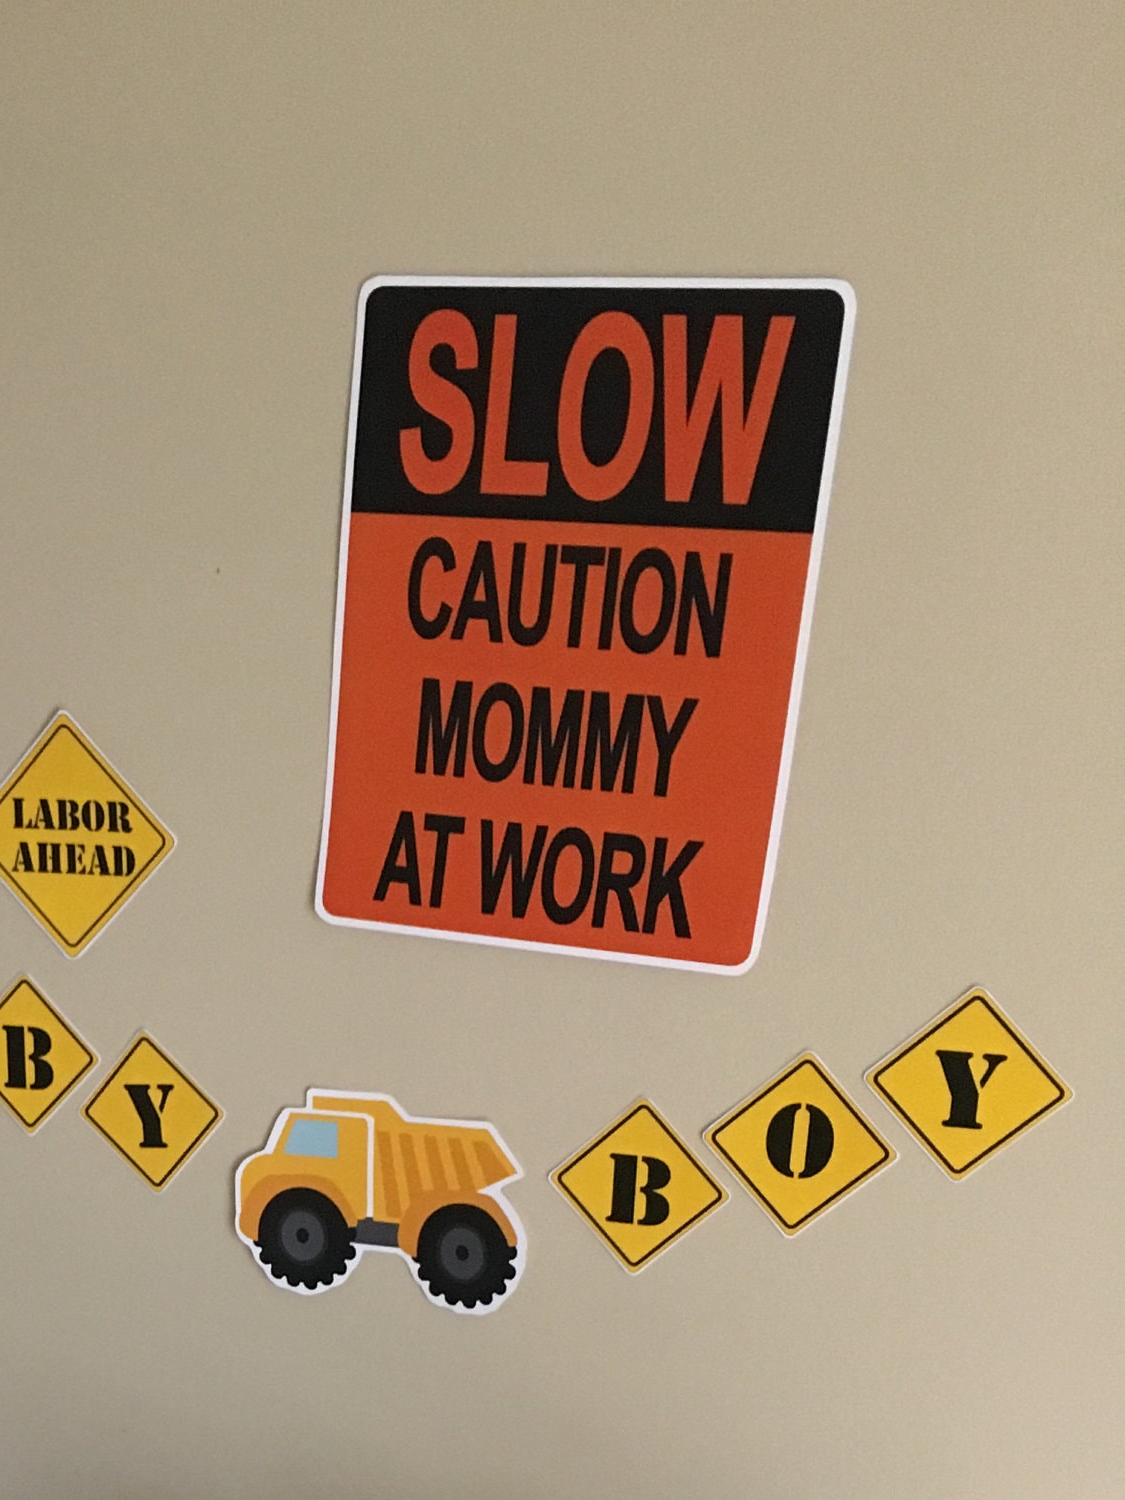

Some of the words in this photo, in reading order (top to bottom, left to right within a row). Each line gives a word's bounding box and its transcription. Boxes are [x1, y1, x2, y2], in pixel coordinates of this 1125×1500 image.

[399, 308, 796, 506] SLOW
[407, 536, 732, 658] CAUTION
[414, 678, 698, 797] MOMMY
[11, 841, 136, 879] AHEAD
[12, 797, 133, 834] LABOR
[373, 811, 464, 909] AT
[479, 819, 704, 939] WORK
